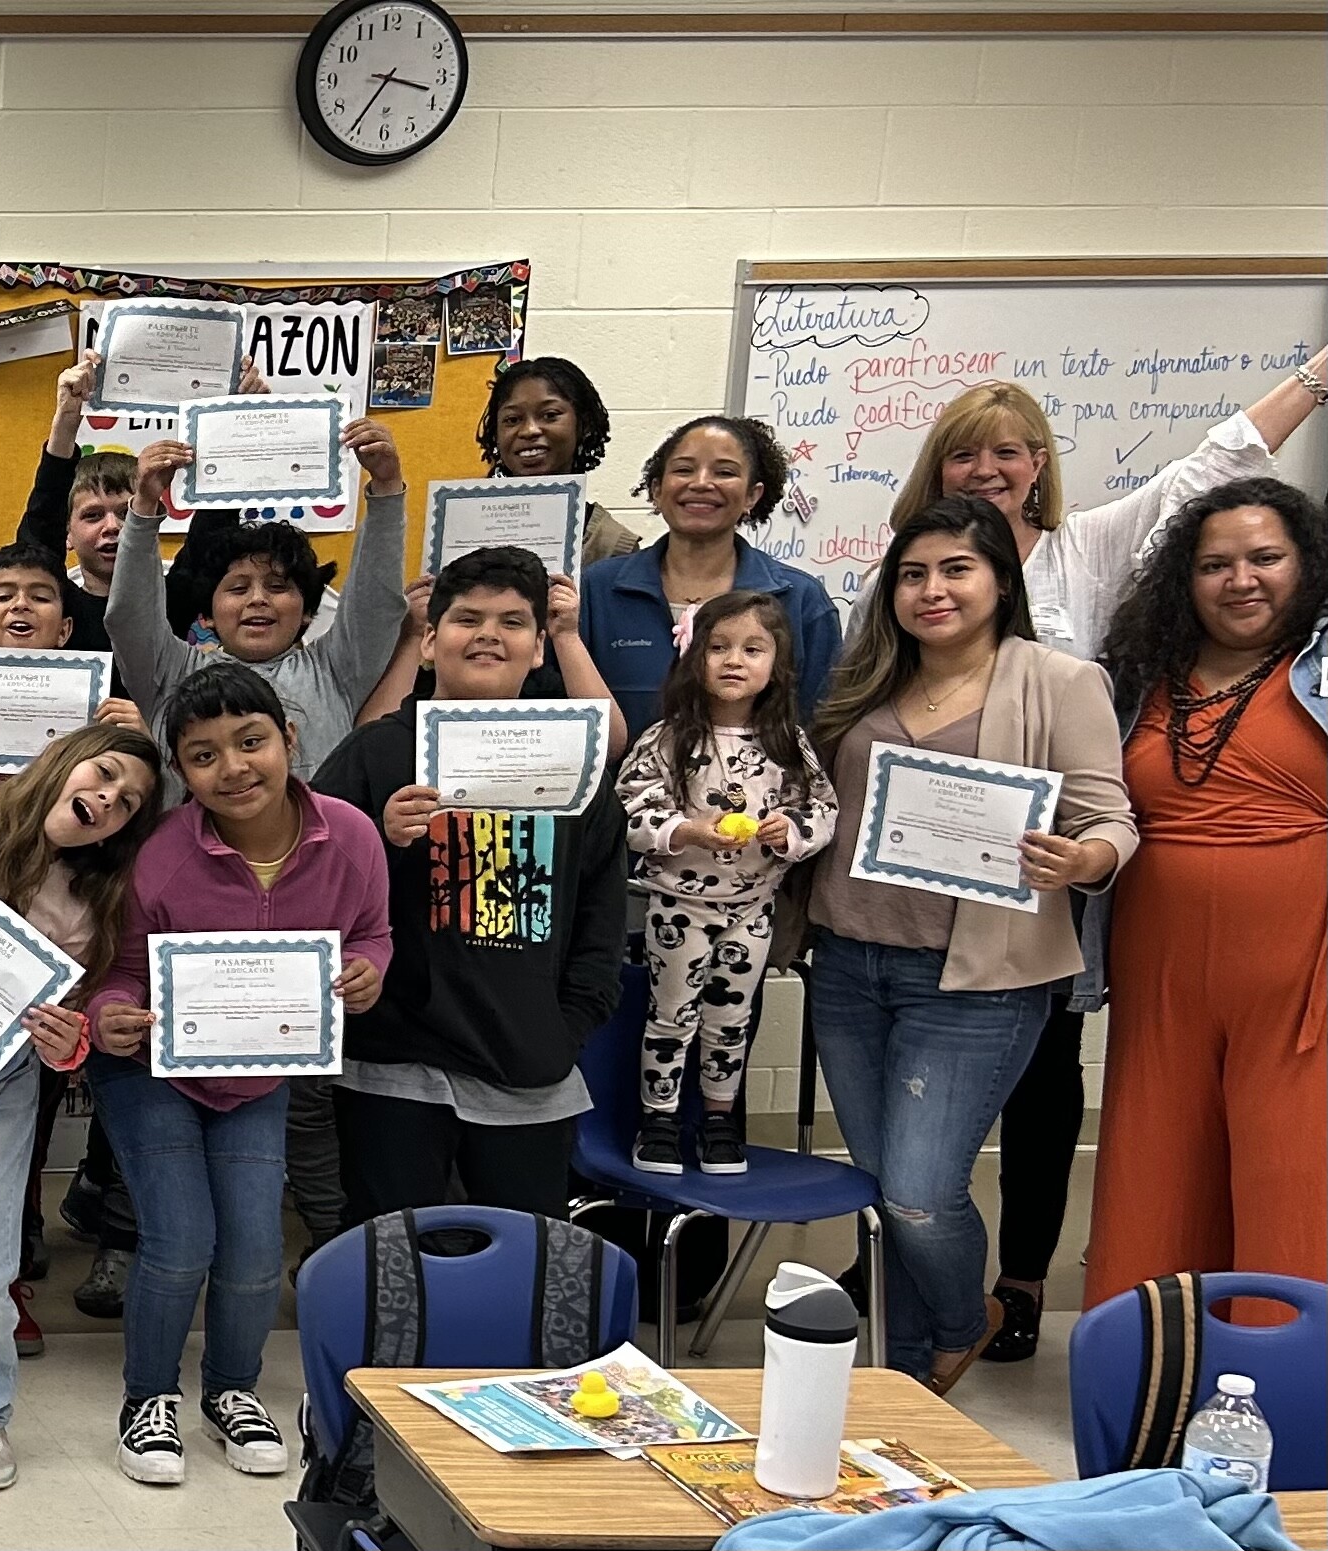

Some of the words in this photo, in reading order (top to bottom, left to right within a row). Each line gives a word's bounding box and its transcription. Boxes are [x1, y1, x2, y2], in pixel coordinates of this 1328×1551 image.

[380, 11, 403, 32] 12
[414, 21, 425, 39] 1
[356, 22, 375, 41] 11
[337, 44, 358, 64] 10
[432, 42, 444, 60] 2
[327, 71, 338, 89] 9
[435, 68, 447, 86] 3
[334, 97, 345, 116] 8
[426, 93, 437, 111] 4
[379, 123, 390, 142] 6
[404, 115, 416, 134] 5
[844, 337, 1007, 393] parafrasear
[1014, 356, 1047, 378] un
[1060, 346, 1115, 378] texto
[1126, 344, 1237, 394] informativo
[1073, 401, 1118, 437] para
